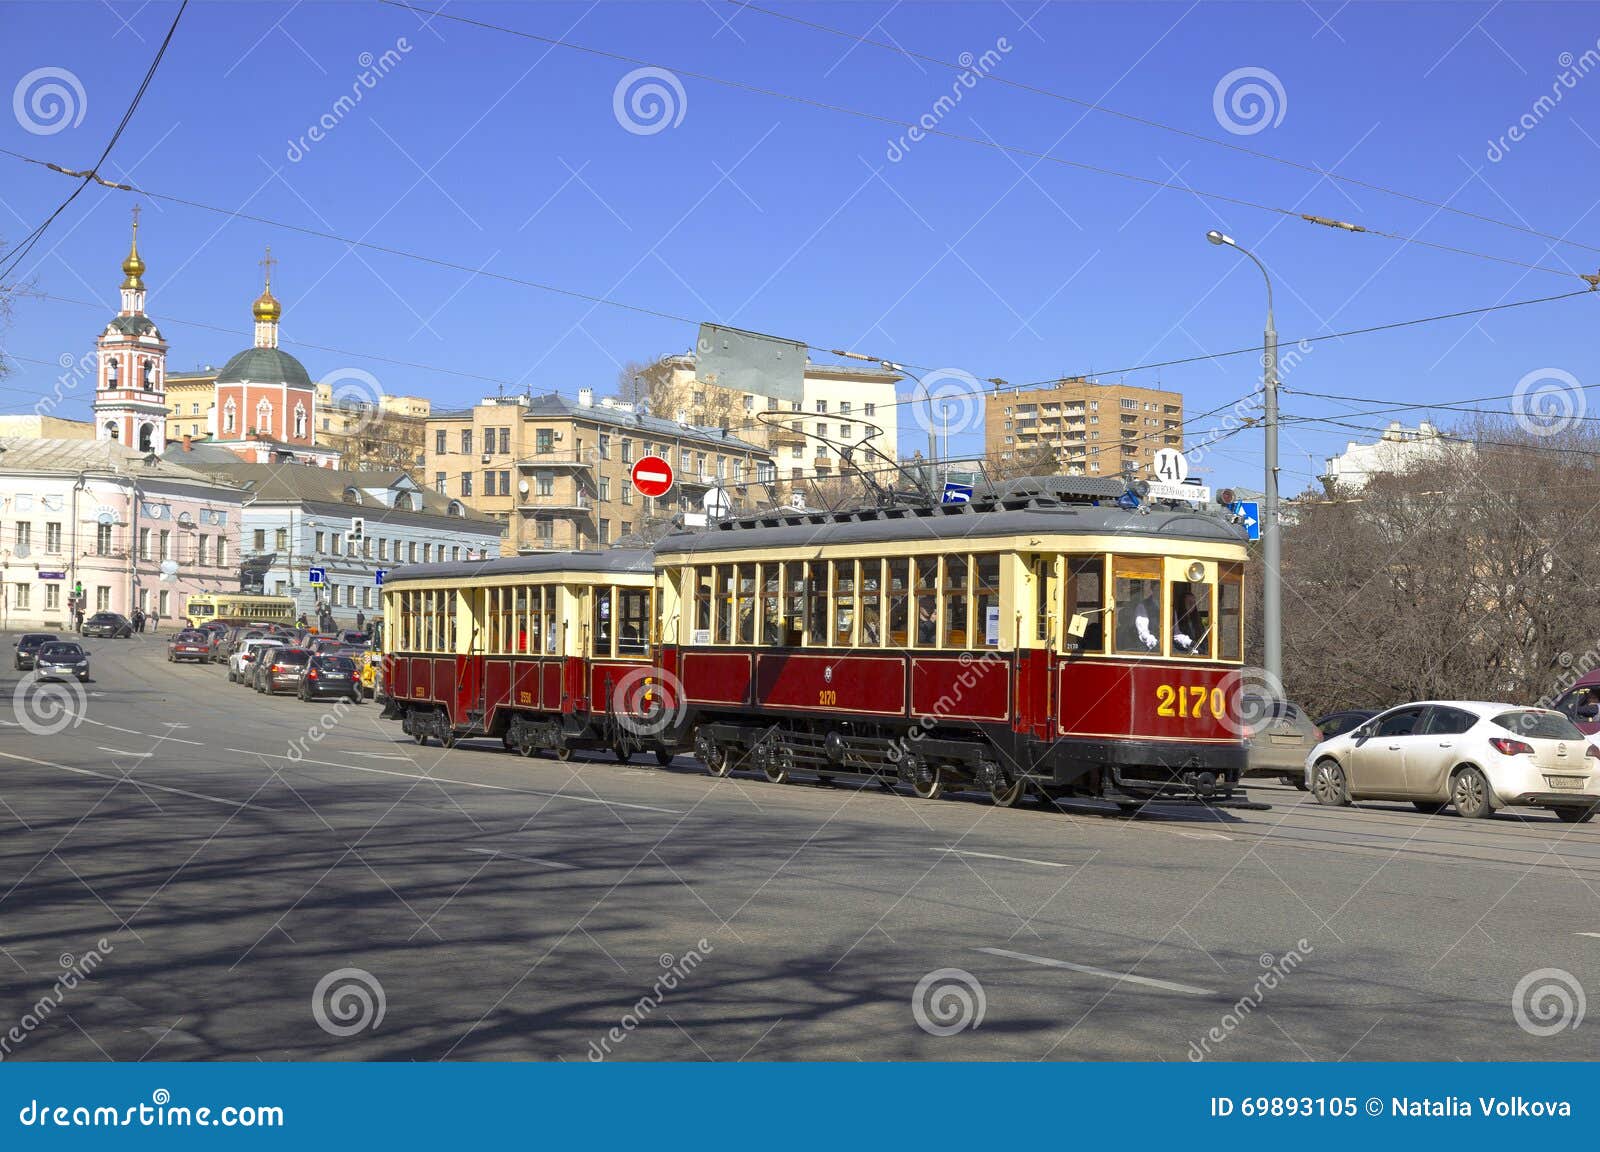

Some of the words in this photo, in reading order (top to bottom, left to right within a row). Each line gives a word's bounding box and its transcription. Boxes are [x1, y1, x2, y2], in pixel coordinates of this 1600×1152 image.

[1160, 454, 1181, 480] 41
[819, 690, 837, 706] 2170
[1155, 684, 1227, 720] 2170
